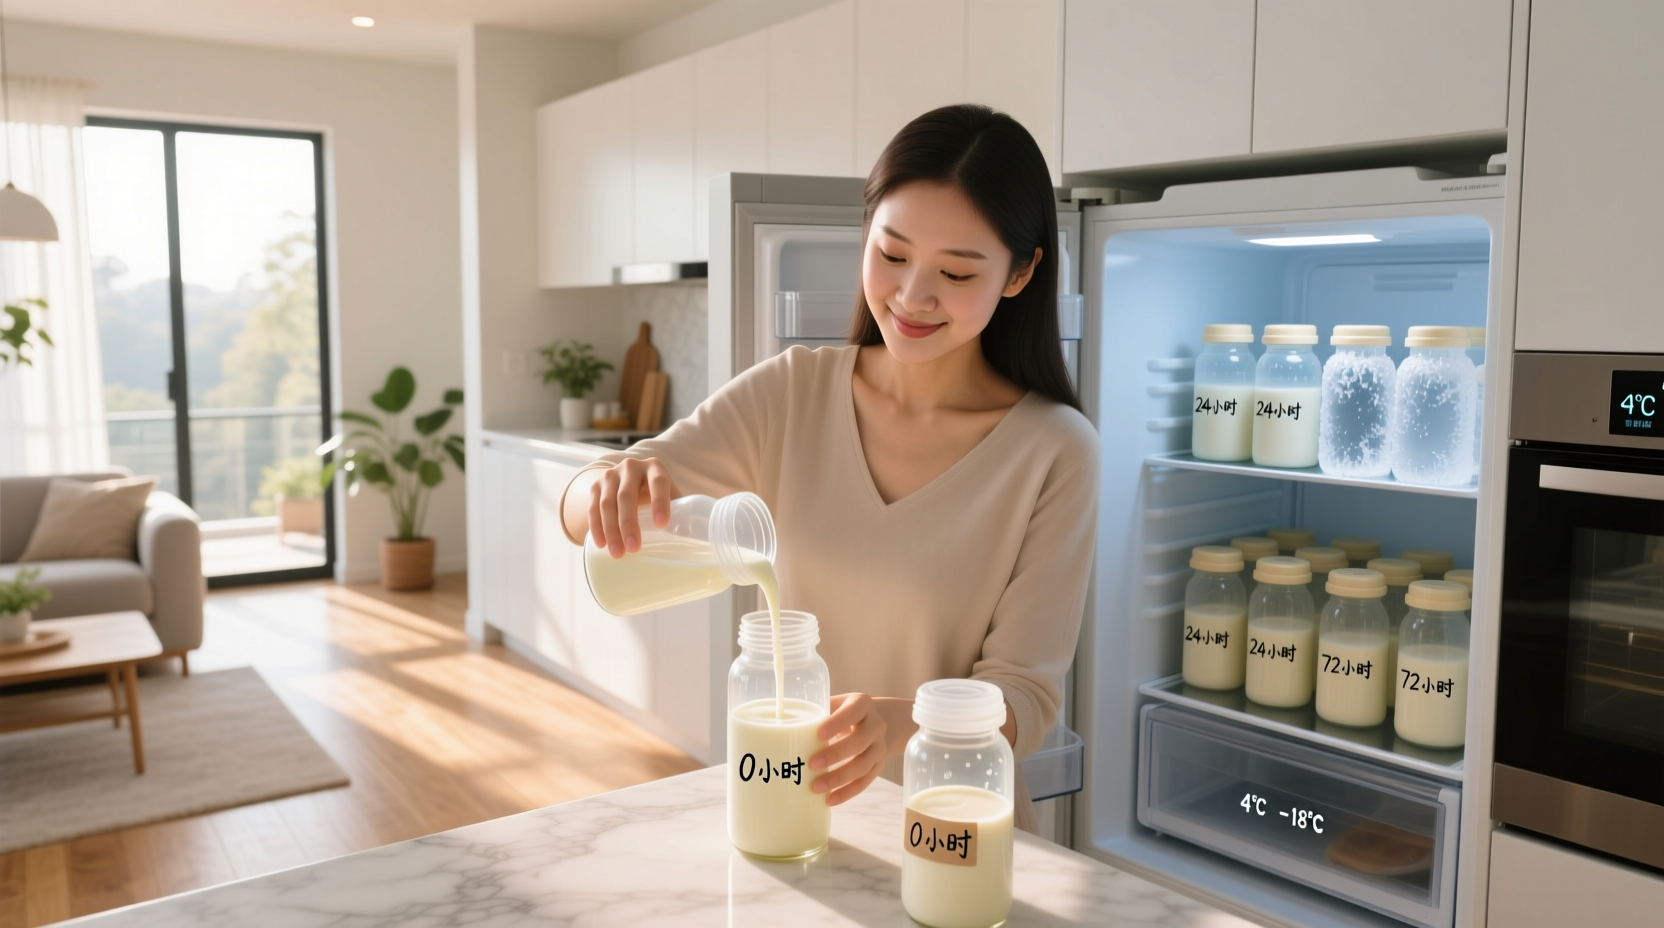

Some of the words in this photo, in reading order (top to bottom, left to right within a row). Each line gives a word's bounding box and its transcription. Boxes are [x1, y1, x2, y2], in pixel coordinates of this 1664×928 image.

[1195, 396, 1237, 416] 24小时
[1256, 400, 1302, 420] 24小时
[1185, 625, 1230, 649] 24小时
[1249, 638, 1297, 663] 24小时
[1321, 653, 1373, 680] 72小时
[1401, 669, 1455, 698] 72小时
[739, 753, 805, 785] 0小时
[909, 821, 972, 859] 0小时
